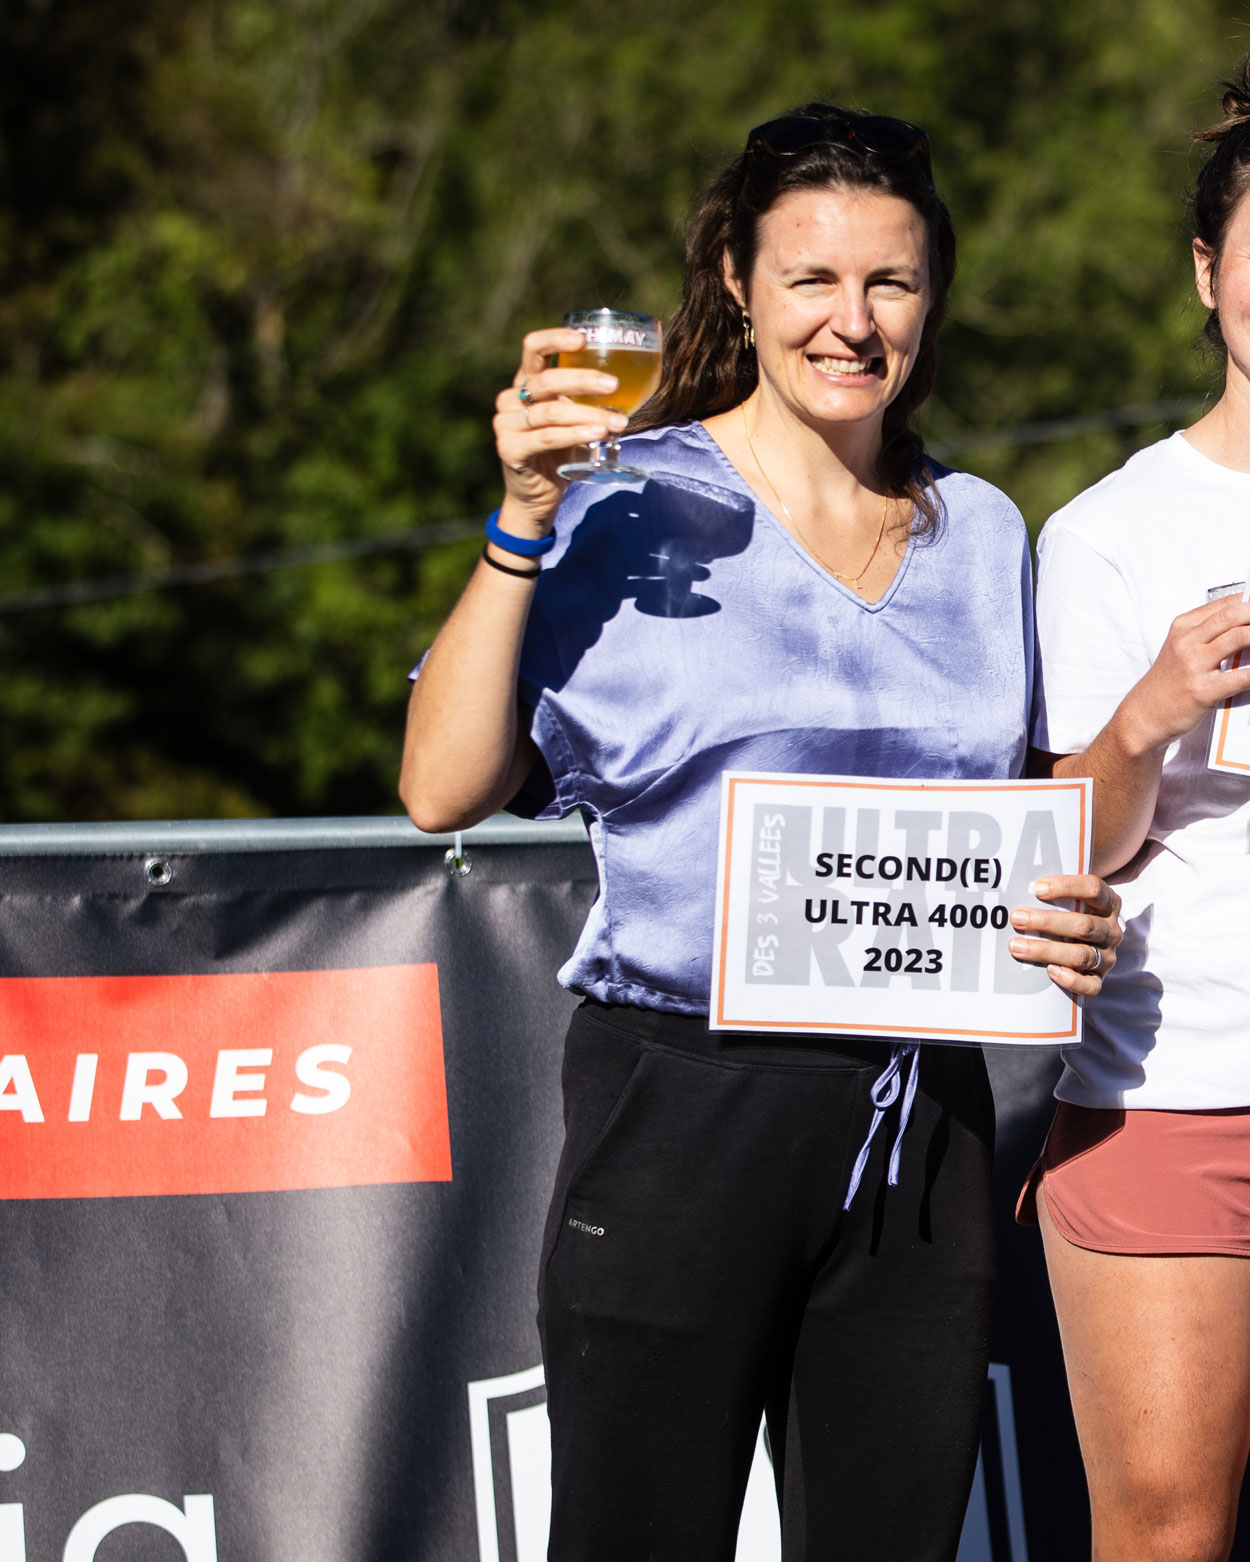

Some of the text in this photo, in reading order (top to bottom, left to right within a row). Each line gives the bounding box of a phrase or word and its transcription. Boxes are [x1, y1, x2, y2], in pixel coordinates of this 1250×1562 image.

[578, 327, 647, 346] HMAY
[785, 803, 1067, 893] ULTRA
[815, 852, 1003, 888] SECOND(E)
[752, 813, 787, 976] DES 3 VALLEES
[805, 898, 1009, 930] ULTRA 4000
[863, 946, 944, 974] 2023
[0, 1043, 353, 1123] AIRES
[568, 1217, 605, 1236] ARTENGO
